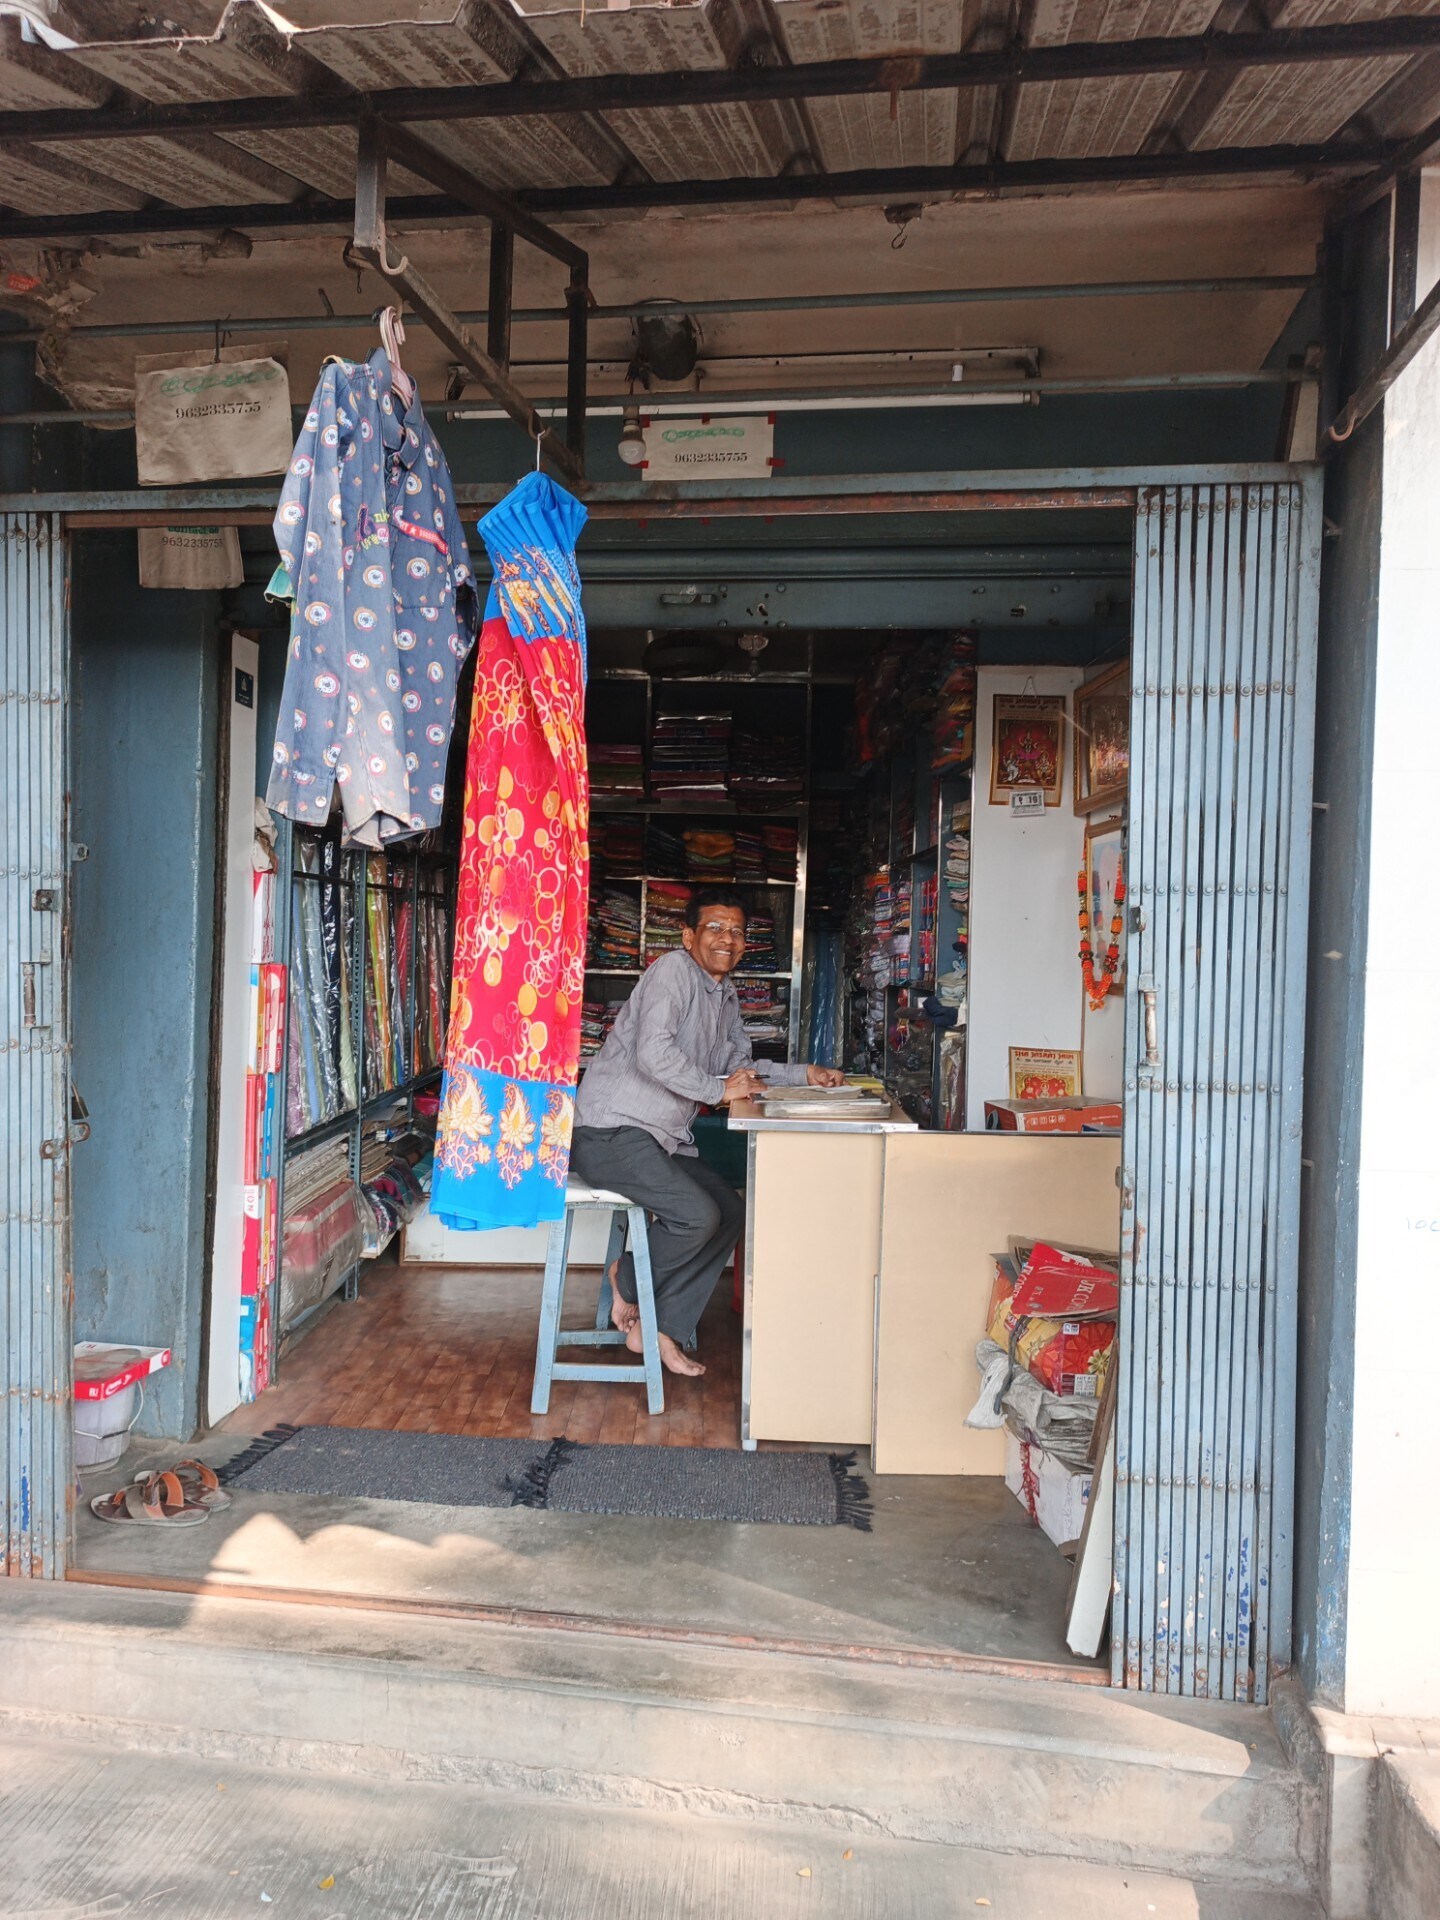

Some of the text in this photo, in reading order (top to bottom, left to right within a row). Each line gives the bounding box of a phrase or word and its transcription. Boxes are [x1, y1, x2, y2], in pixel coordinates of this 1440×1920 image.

[175, 401, 261, 419] 9632335755
[674, 452, 748, 463] 9632335755
[162, 536, 224, 548] 9632335755
